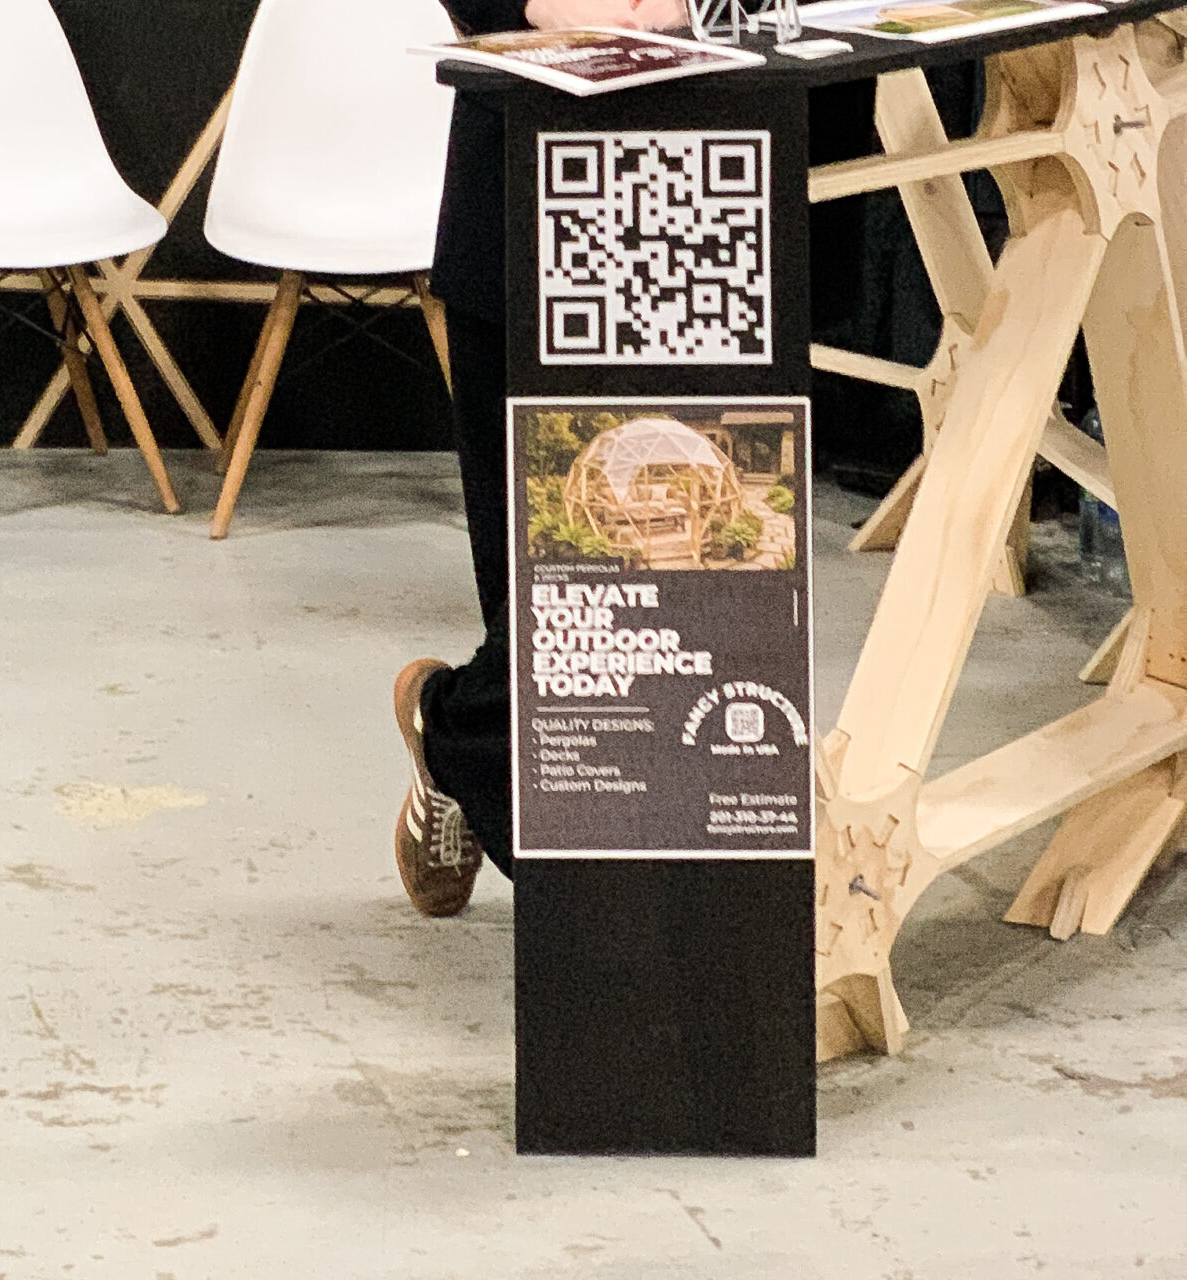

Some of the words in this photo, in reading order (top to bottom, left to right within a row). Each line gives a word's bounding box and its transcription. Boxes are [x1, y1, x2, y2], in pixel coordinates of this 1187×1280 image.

[531, 583, 659, 607] ELEVATE
[530, 606, 614, 629] YOUR
[532, 628, 680, 651] OUTDOOR
[532, 650, 713, 675] EXPERIENCE
[531, 673, 635, 697] TODAY
[682, 688, 719, 746] FANCY
[723, 681, 809, 747] STRUCTURE
[532, 718, 590, 733] QUALITY
[540, 734, 597, 749] Pergolas
[540, 748, 580, 761] Decks
[540, 763, 574, 776] Patio
[576, 763, 621, 777] Covers
[540, 778, 591, 792] Custom
[594, 778, 647, 795] Designs
[709, 792, 738, 805] Free
[740, 793, 798, 806] Estimate
